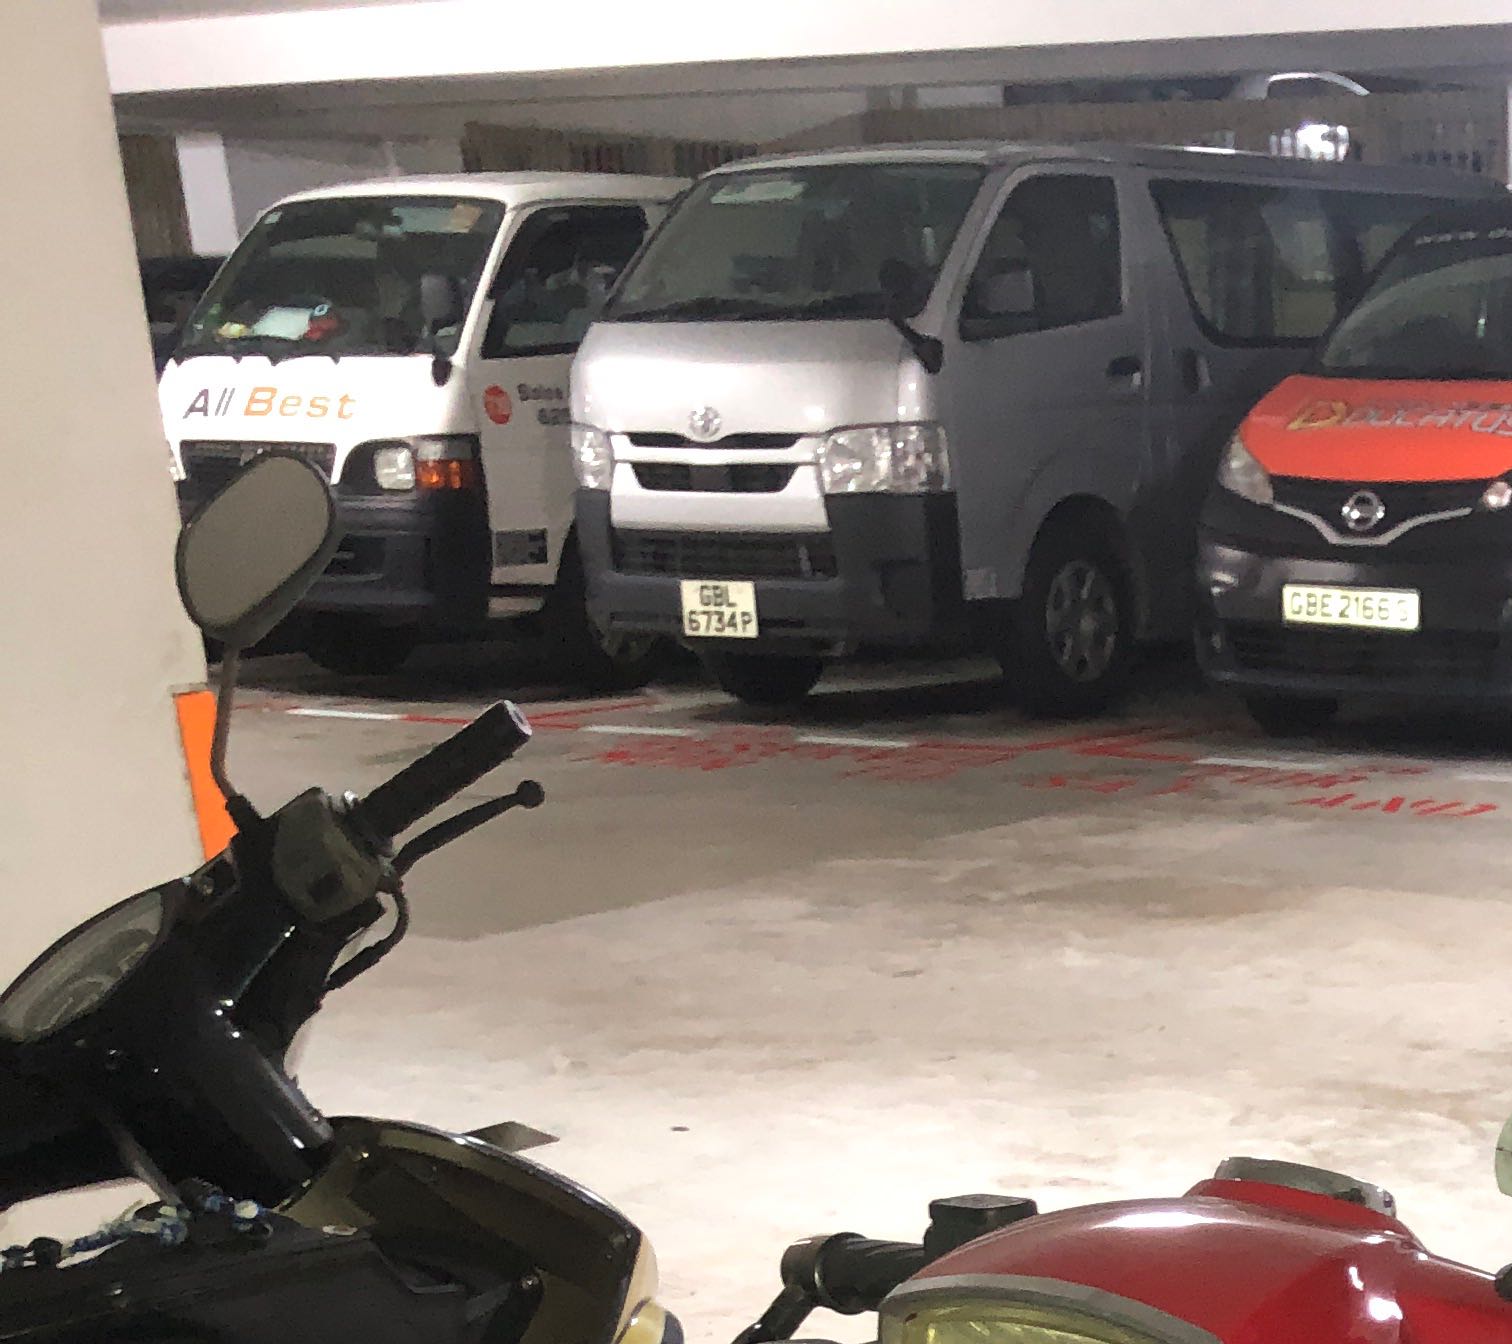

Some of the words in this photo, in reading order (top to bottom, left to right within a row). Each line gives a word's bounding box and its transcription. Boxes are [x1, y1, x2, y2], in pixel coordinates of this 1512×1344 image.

[182, 387, 236, 420] All
[243, 386, 357, 420] Best
[688, 610, 752, 633] 6734P
